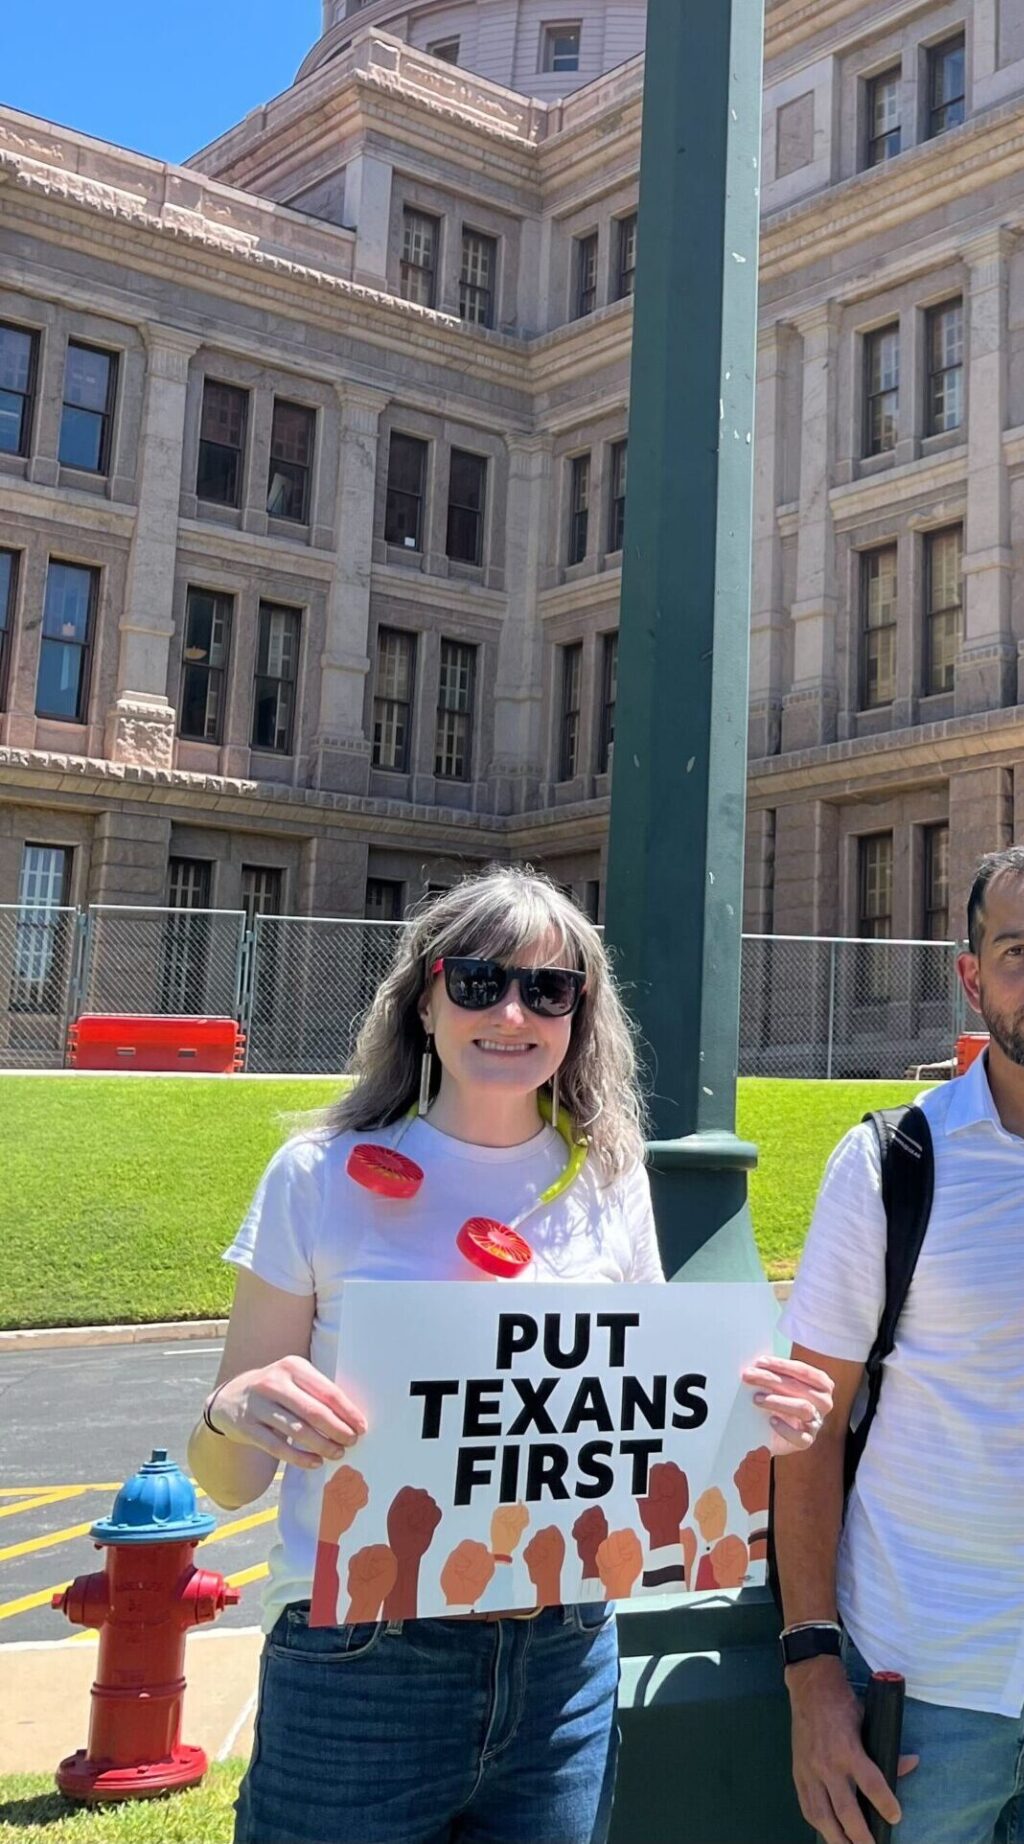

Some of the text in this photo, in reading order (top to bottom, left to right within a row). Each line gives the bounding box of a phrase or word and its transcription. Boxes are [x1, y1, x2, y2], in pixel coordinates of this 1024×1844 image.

[496, 1312, 640, 1371] PUT
[409, 1373, 708, 1439] TEXANS
[453, 1438, 664, 1506] FIRST
